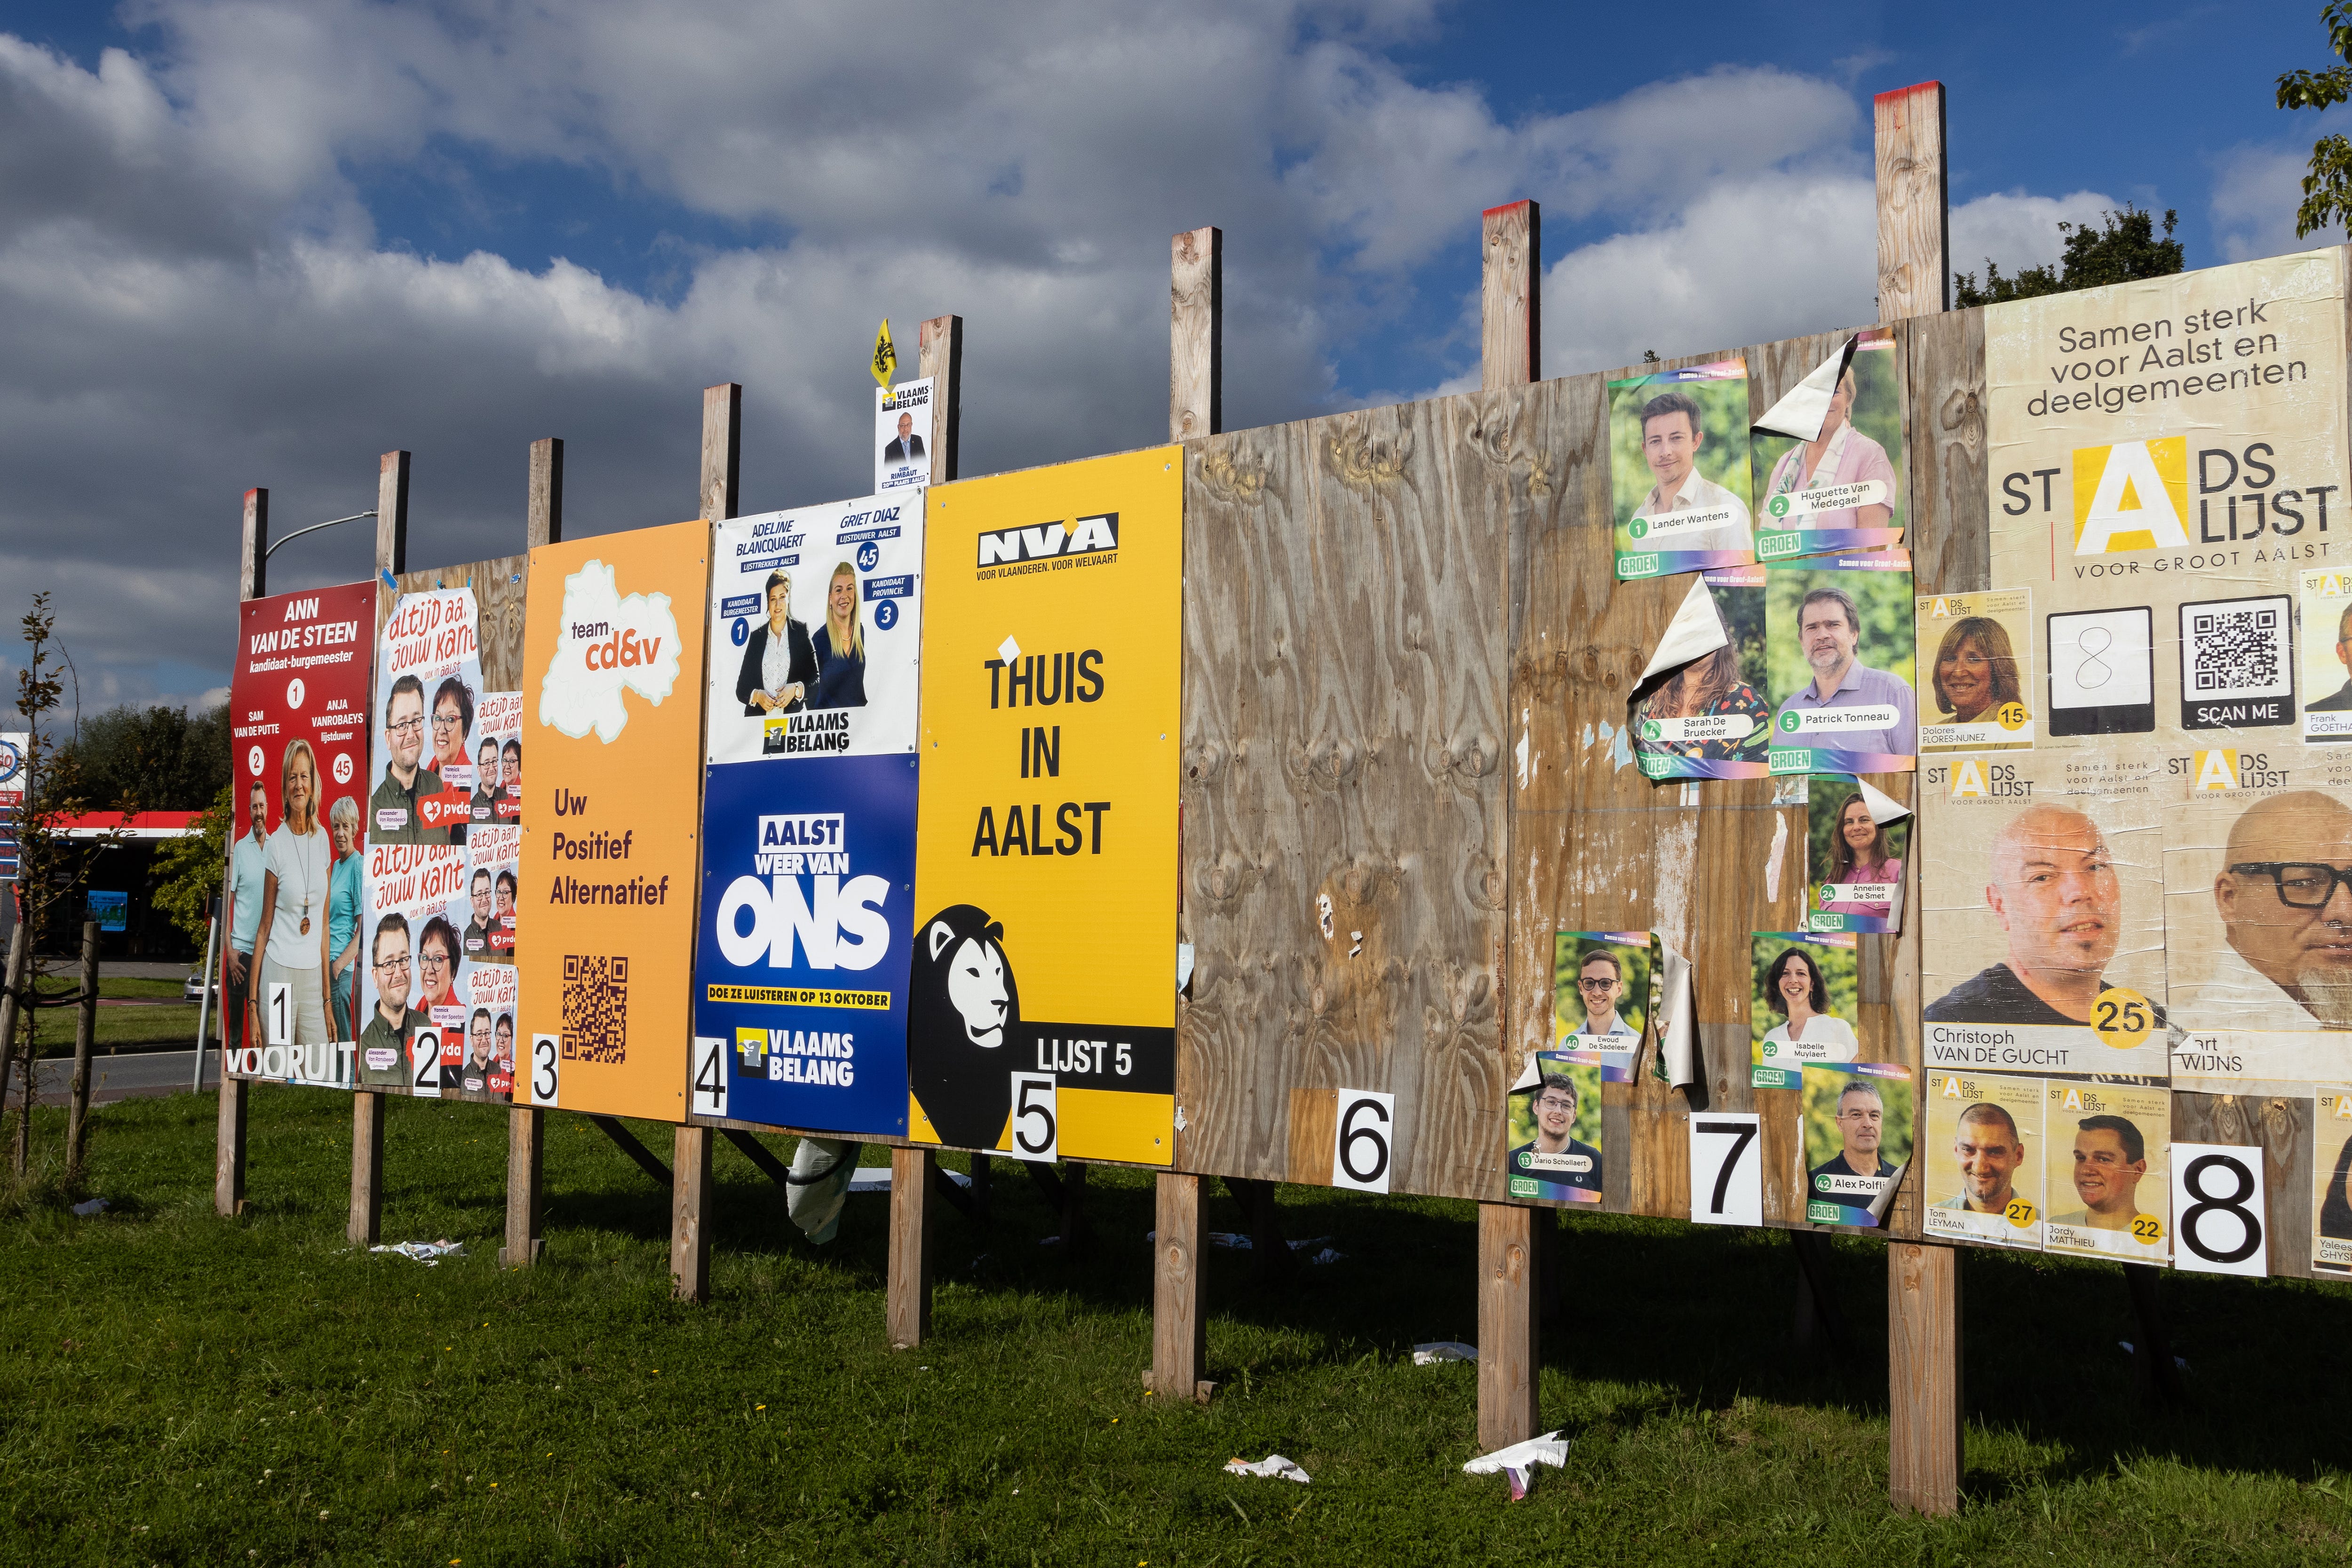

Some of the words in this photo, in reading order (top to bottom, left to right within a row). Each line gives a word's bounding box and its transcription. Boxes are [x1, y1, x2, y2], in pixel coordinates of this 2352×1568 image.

[2059, 319, 2172, 353] Samen
[2185, 298, 2268, 334] sterk
[2051, 355, 2130, 383] voor
[2139, 338, 2223, 372] Aalst
[2234, 333, 2277, 357] en
[897, 386, 929, 400] VLAAMS
[2027, 359, 2306, 417] deelgemeenten
[897, 395, 929, 409] BELANG
[891, 469, 917, 479] RIMBAUT
[1801, 485, 1849, 503] Huguette
[1850, 483, 1870, 492] Van
[1776, 503, 1783, 514] 2
[1811, 496, 1860, 510] Medegael
[840, 512, 872, 529] GRIET
[873, 507, 900, 523] DIAZ
[1636, 525, 1641, 535] 1
[1653, 517, 1685, 529] Lander
[1687, 511, 1729, 524] Wantens
[2201, 486, 2338, 544] LIJST
[752, 520, 795, 538] ADELINE
[840, 532, 876, 543] LIJSTDUWER
[878, 529, 897, 538] AALST
[736, 534, 806, 556] BLANCQUAERT
[743, 560, 778, 571] LIJSTTREKKER
[780, 557, 796, 565] AALST
[859, 548, 877, 566] 45
[1621, 555, 1657, 573] GROEN
[2074, 562, 2141, 579] VOOR
[2153, 552, 2240, 572] GROOT
[2255, 543, 2330, 563] AALST
[977, 570, 996, 581] VOOR
[998, 562, 1049, 578] VLAANDEREN.
[1052, 559, 1073, 571] VOOR
[1075, 554, 1118, 568] WELVAART
[872, 578, 905, 588] KANDIDAAT
[873, 587, 904, 597] PROVINCIE
[284, 598, 319, 622] ANN
[723, 605, 758, 617] BURGEMEESTER
[727, 598, 755, 607] KANDIDAAT
[881, 607, 891, 623] 3
[251, 632, 278, 654] VAN
[281, 629, 299, 649] DE
[303, 621, 357, 647] STEEN
[572, 621, 609, 639] team
[738, 624, 743, 639] 1
[586, 628, 661, 671] cd&v
[249, 651, 353, 673] kandidaat-burgemeester
[985, 649, 1104, 709] THUIS
[293, 686, 298, 702] 1
[326, 699, 348, 711] ANJA
[2197, 706, 2246, 722] SCAN
[2252, 704, 2279, 720] ME
[248, 711, 263, 721] SAM
[312, 713, 363, 728] VANROBAEYS
[789, 712, 849, 733] VLAAMS
[1684, 719, 1711, 727] Sarah
[1786, 718, 1794, 729] 5
[1806, 714, 1842, 724] Patrick
[1844, 713, 1890, 722] Tonneau
[2001, 708, 2023, 723] 15
[234, 728, 248, 737] VAN
[249, 727, 257, 736] DE
[258, 723, 279, 735] PUTTE
[321, 731, 352, 744] lijstduwer
[1649, 727, 1656, 737] 4
[1684, 728, 1726, 737] Bruecker
[1923, 734, 1986, 743] FLORES-NUNEZ
[787, 732, 850, 753] BELANG
[1021, 725, 1060, 778] IN
[254, 753, 260, 768] 2
[336, 761, 350, 776] 45
[1771, 752, 1809, 768] GROEN
[444, 801, 470, 817] pvda
[555, 788, 588, 816] Uw
[763, 819, 840, 846] AALST
[971, 801, 1111, 856] AALST
[553, 830, 632, 860] Positief
[754, 854, 804, 875] WEER
[806, 853, 849, 874] VAN
[376, 874, 415, 910] jouw
[420, 859, 464, 902] kant
[550, 875, 668, 905] Alternatief
[1823, 890, 1834, 898] 24
[716, 875, 890, 970] ONS
[709, 988, 728, 998] DOE
[731, 989, 742, 999] ZE
[745, 989, 797, 1002] LUISTEREN
[800, 991, 815, 1002] OP
[819, 993, 831, 1004] 13
[834, 993, 888, 1006] OKTOBER
[274, 988, 285, 1039] 1
[2097, 1001, 2145, 1032] 25
[769, 1029, 853, 1059] VLAAMS
[1933, 1027, 2014, 1048] Christoph
[226, 1041, 356, 1083] VOORUIT
[415, 1032, 439, 1088] 2
[1038, 1038, 1107, 1074] LIJST
[1115, 1044, 1131, 1076] 5
[1933, 1045, 1969, 1061] VAN
[1975, 1047, 1996, 1063] DE
[2002, 1049, 2069, 1065] GUCHT
[2181, 1055, 2242, 1071] WIJNS
[534, 1039, 557, 1100] 3
[695, 1044, 725, 1108] 4
[769, 1057, 854, 1087] BELANG
[1756, 1071, 1783, 1083] GROEN
[1016, 1080, 1055, 1154] 5
[1339, 1099, 1389, 1183] 6
[1696, 1122, 1757, 1214] 7
[1929, 1209, 1947, 1218] Tom
[2009, 1204, 2033, 1220] 27
[2180, 1155, 2262, 1263] 8
[1929, 1218, 1964, 1229] LEYMAN
[2050, 1226, 2074, 1236] Jordy
[2134, 1220, 2158, 1237] 22
[2050, 1235, 2095, 1247] MATTHIEU
[2320, 1239, 2352, 1251] Yalees
